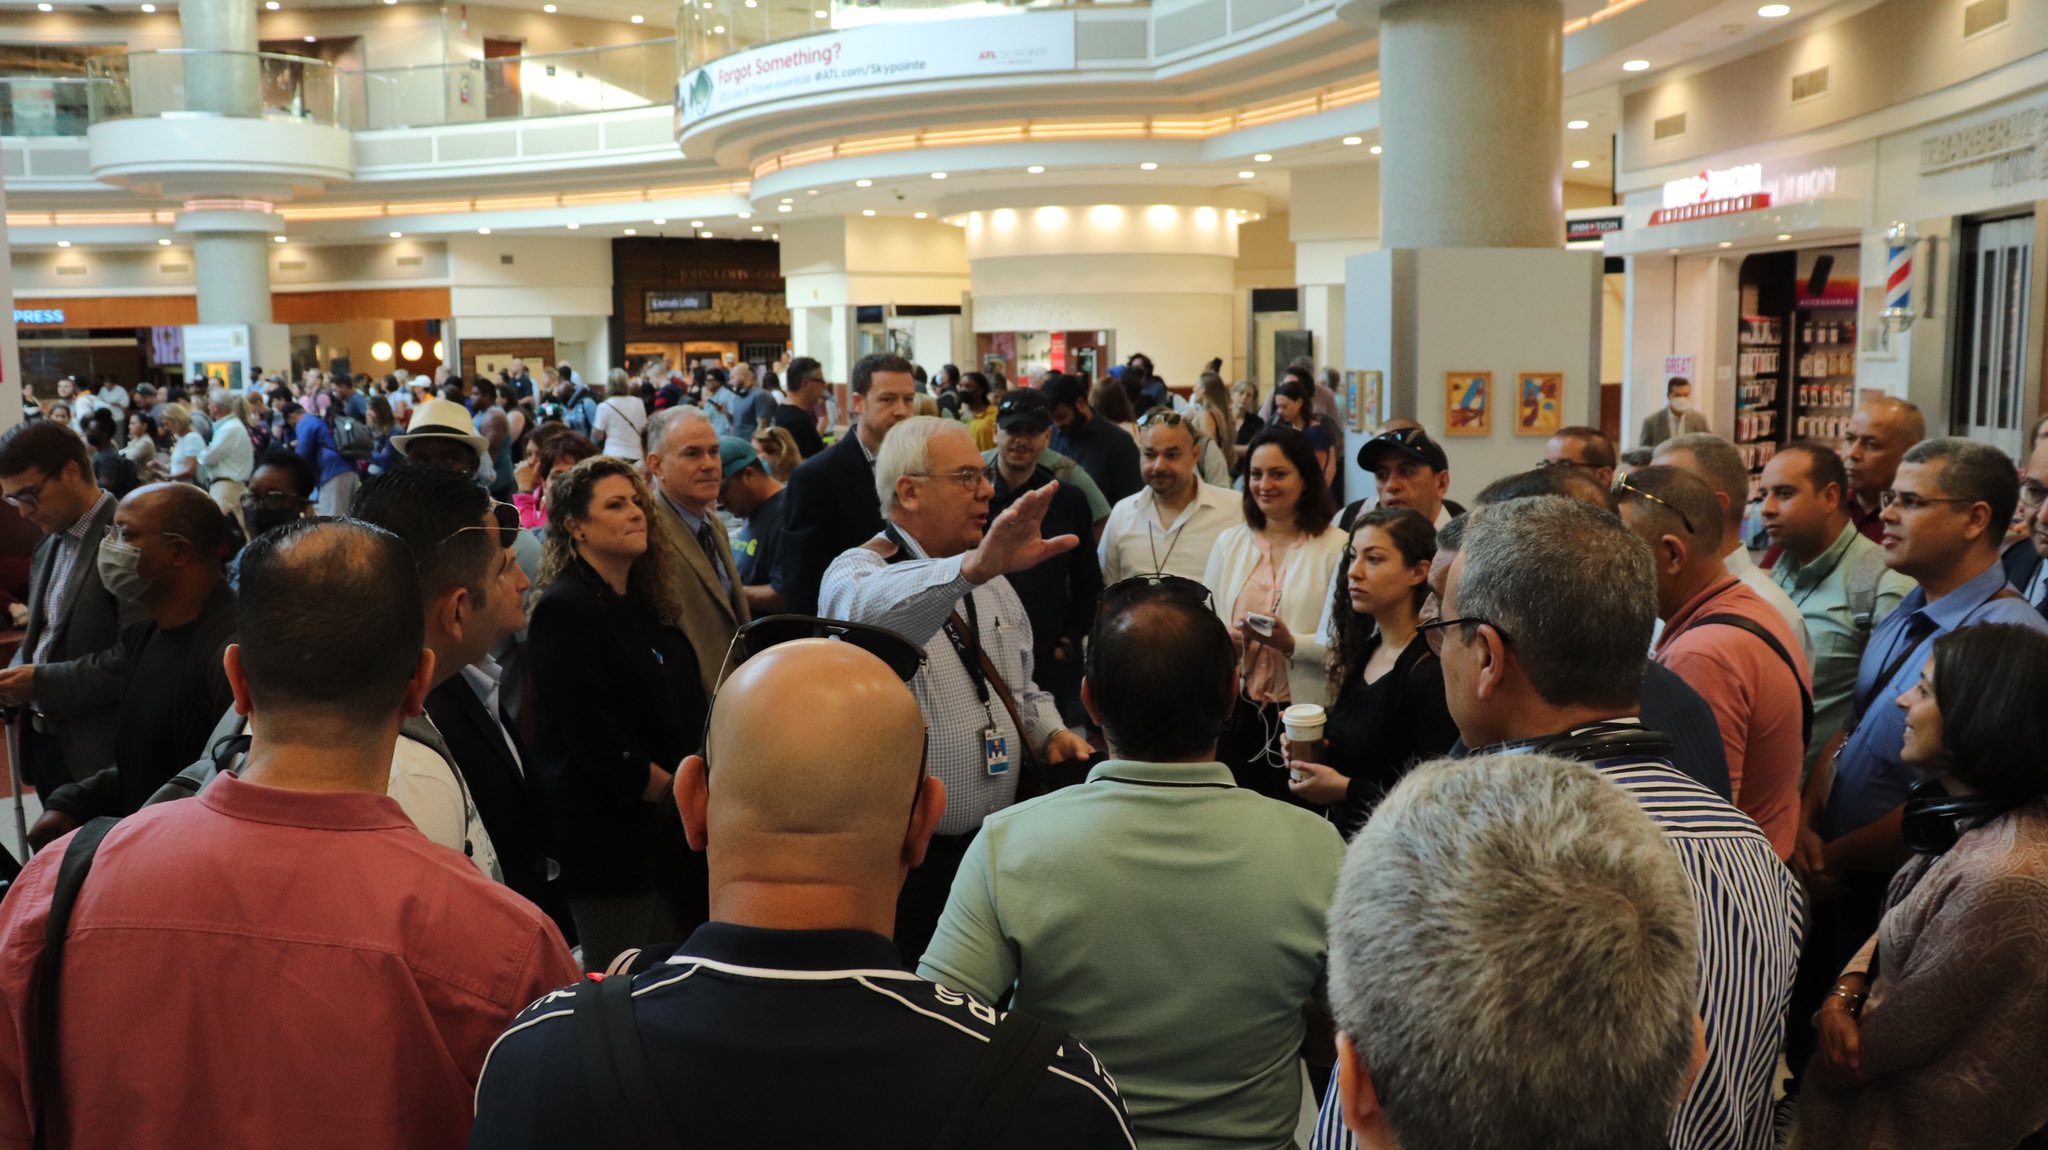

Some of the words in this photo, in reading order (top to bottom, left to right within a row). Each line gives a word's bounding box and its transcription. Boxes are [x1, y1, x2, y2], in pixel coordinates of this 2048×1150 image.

[978, 50, 998, 60] ATL
[719, 64, 751, 85] Forgot
[755, 42, 842, 75] Something?
[1800, 298, 1854, 306] ACCESSORIES
[13, 309, 64, 323] PRESS
[1665, 357, 1691, 373] GREAT
